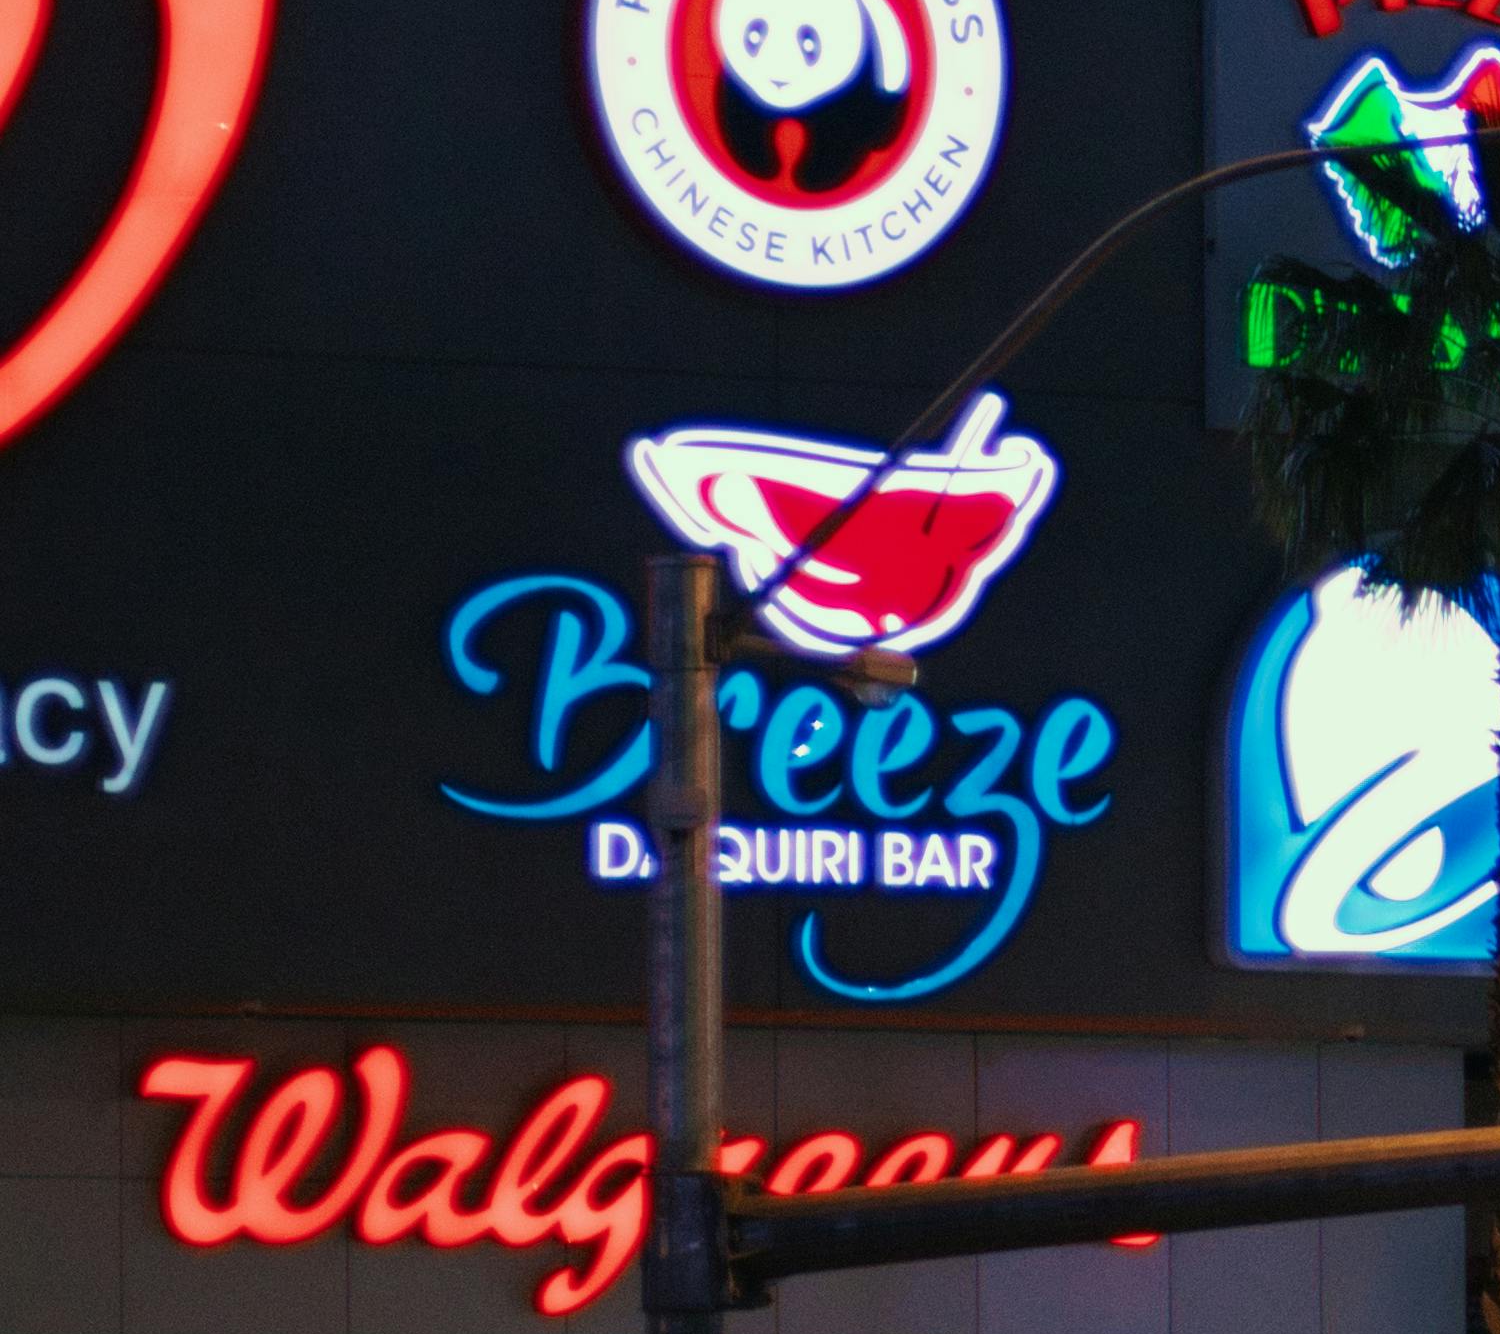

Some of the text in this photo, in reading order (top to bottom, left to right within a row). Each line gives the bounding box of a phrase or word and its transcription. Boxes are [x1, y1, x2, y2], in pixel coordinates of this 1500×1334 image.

[629, 104, 972, 267] CHINESE KITCHEN
[597, 823, 994, 890] DQUIRI BAR
